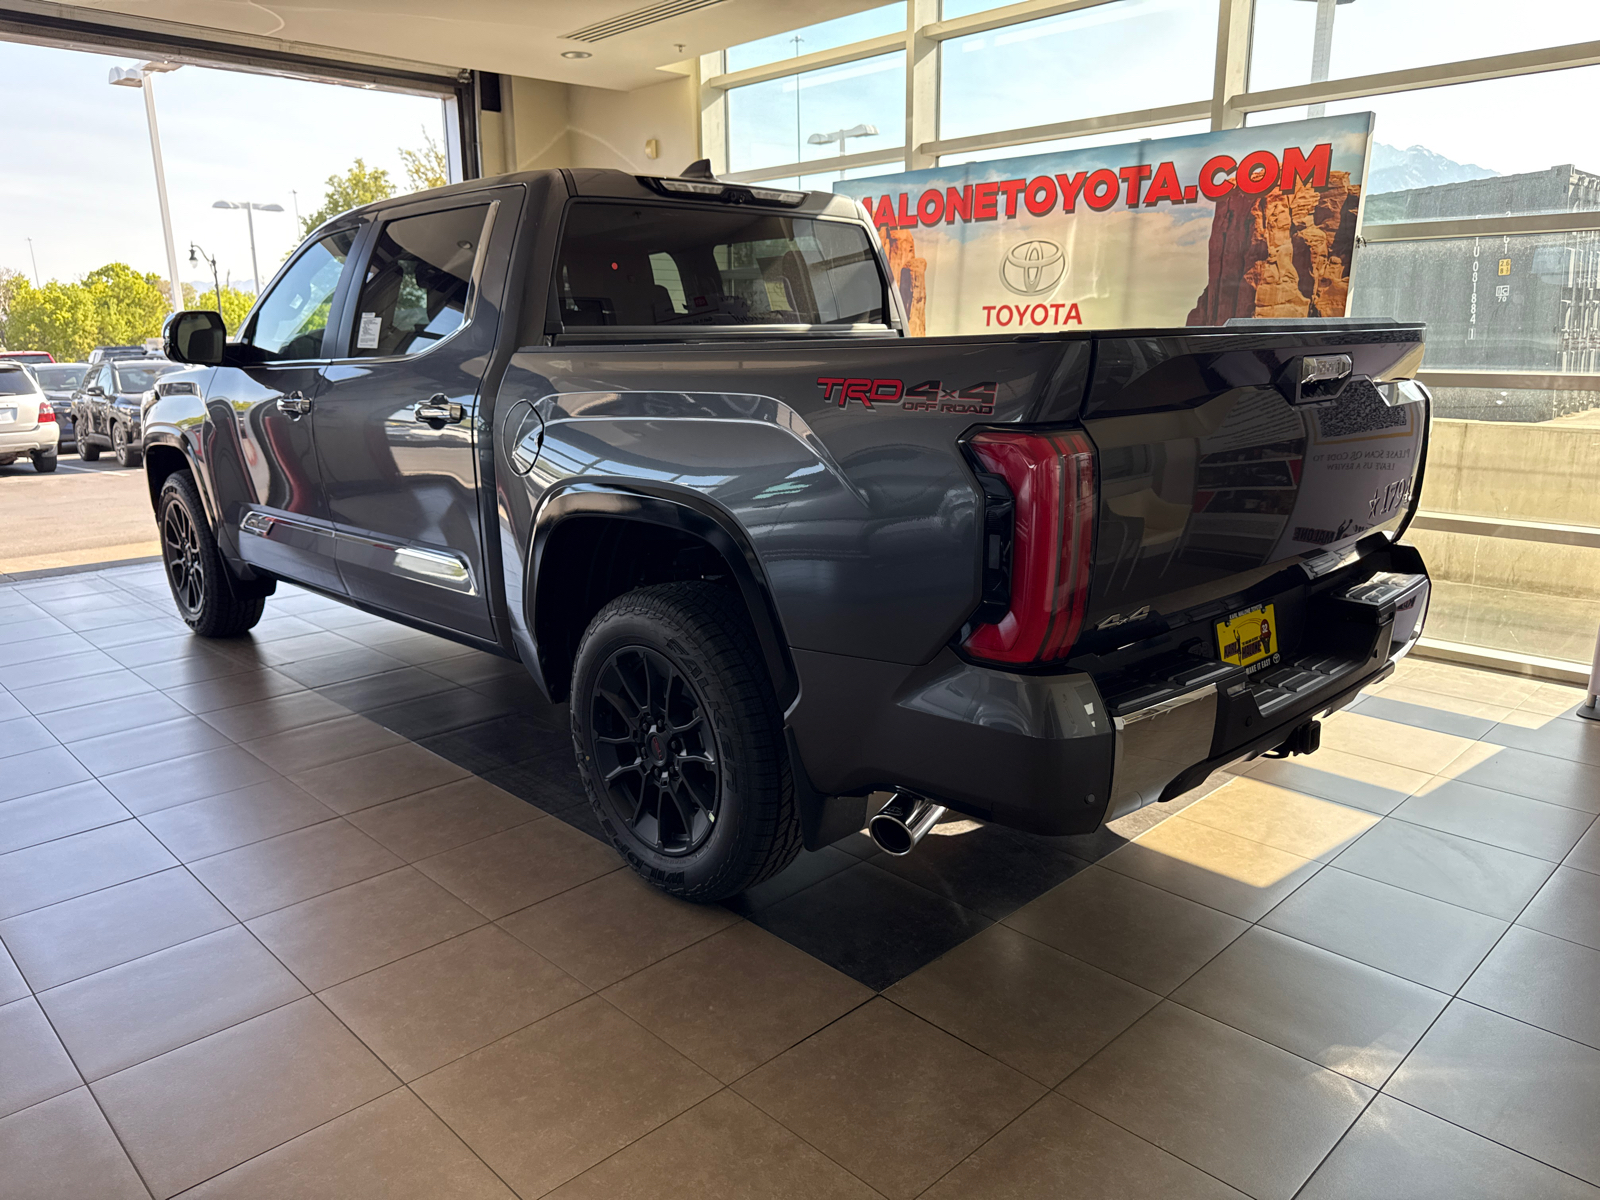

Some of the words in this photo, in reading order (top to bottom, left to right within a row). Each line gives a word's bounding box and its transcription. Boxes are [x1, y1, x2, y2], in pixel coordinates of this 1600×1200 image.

[982, 303, 1083, 327] TOYOTA
[817, 377, 904, 412] TRD
[902, 401, 940, 412] OFF
[940, 402, 995, 416] ROAD
[1096, 605, 1151, 631] 4x4
